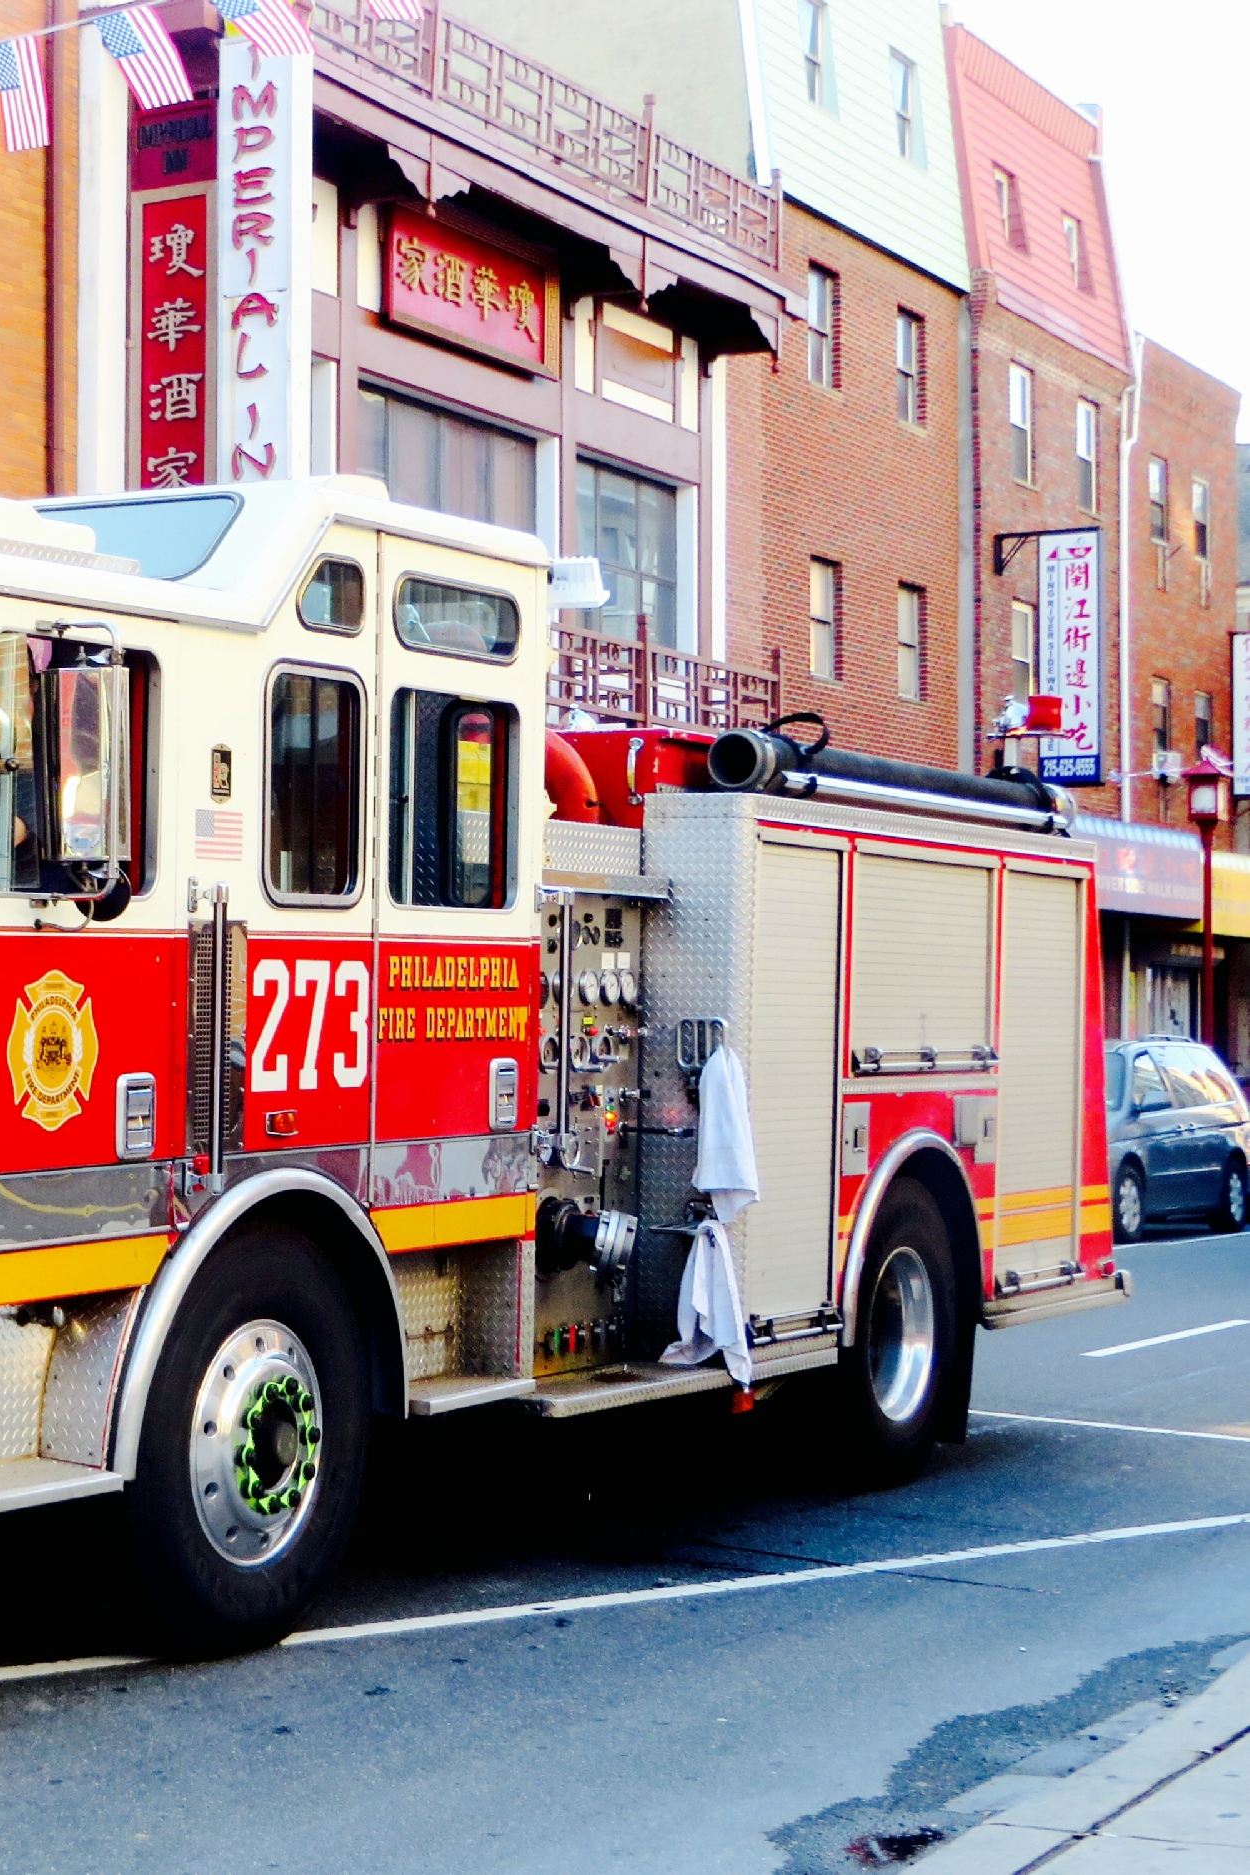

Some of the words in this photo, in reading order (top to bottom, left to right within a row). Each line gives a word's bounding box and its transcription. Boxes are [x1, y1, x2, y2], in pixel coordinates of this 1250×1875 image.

[388, 955, 520, 990] PHILADELPHIA
[30, 995, 77, 1021] PHILADELPHIA
[251, 958, 370, 1092] 273
[378, 1007, 416, 1042] FIRE
[425, 1006, 528, 1042] DEPARTMENT
[37, 1070, 80, 1105] DEPARTMENT
